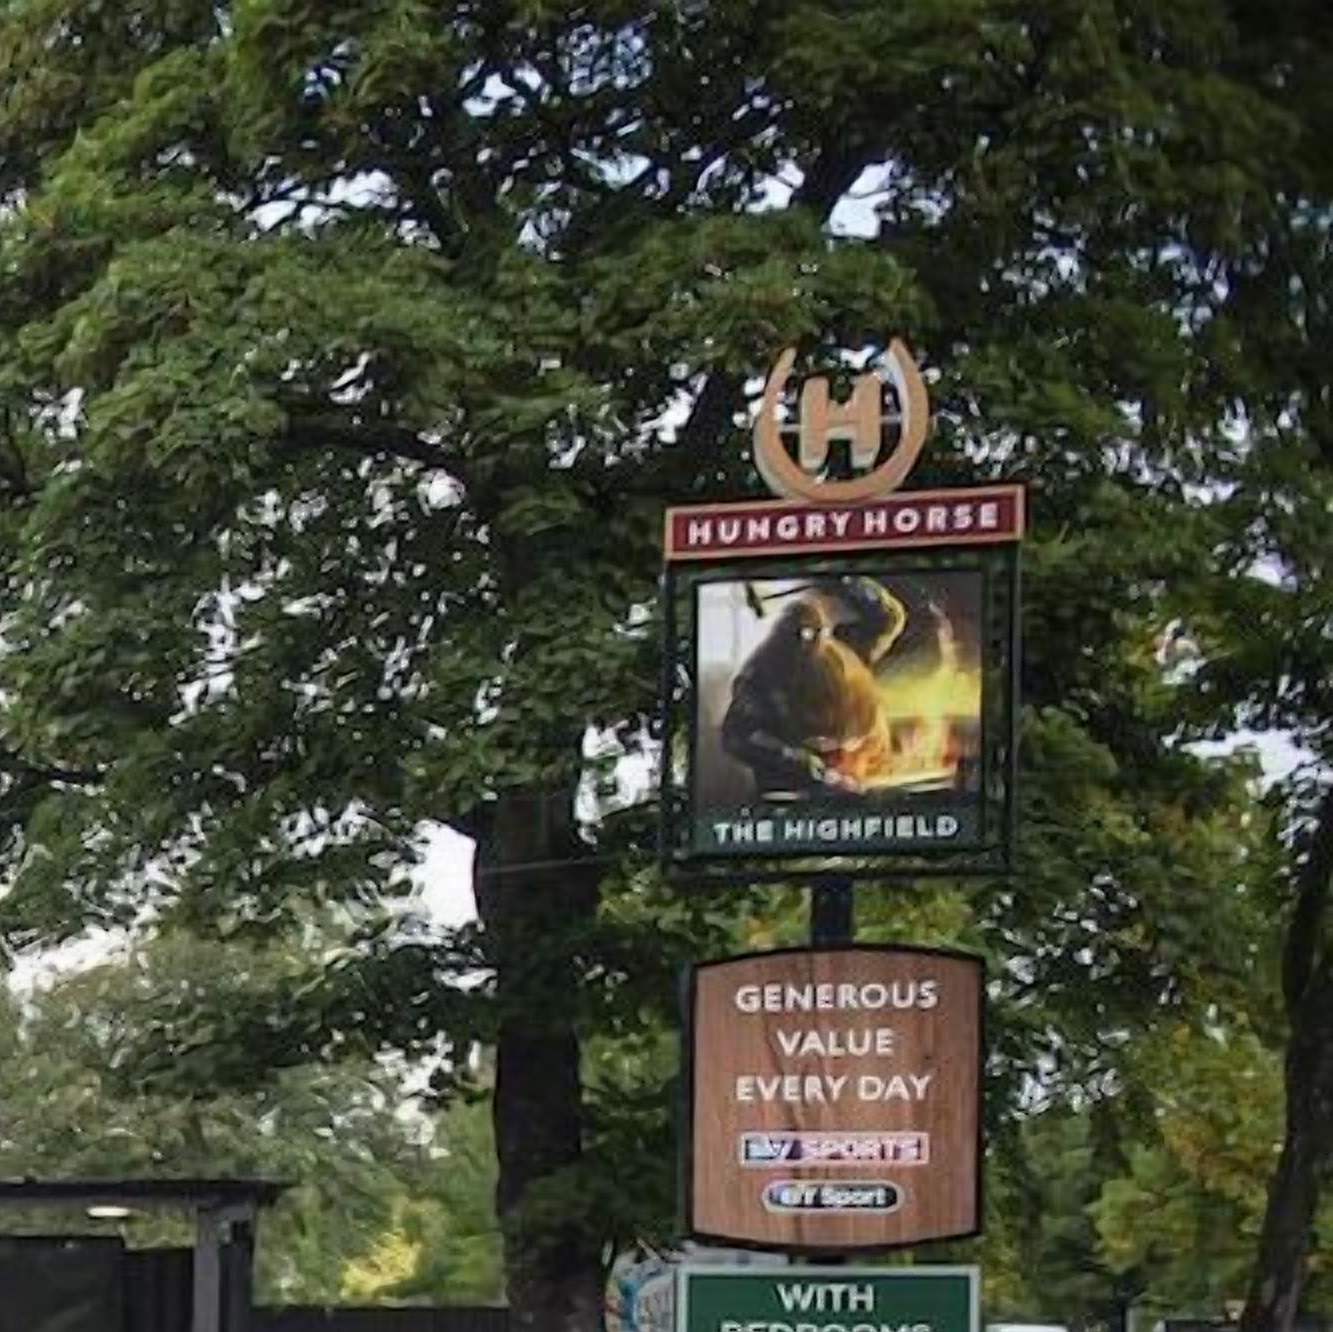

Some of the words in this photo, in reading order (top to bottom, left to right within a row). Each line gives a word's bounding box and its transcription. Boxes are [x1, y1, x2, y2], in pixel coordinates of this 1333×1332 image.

[688, 511, 852, 545] HUNGRY
[863, 502, 999, 538] HORSE
[714, 821, 774, 844] THE
[784, 815, 959, 843] HIGHFIELD
[735, 981, 939, 1013] GENEROUS
[777, 1029, 895, 1057] VALUE
[736, 1076, 844, 1103] EVERY
[858, 1074, 932, 1101] DAY
[777, 1283, 874, 1312] WITH
